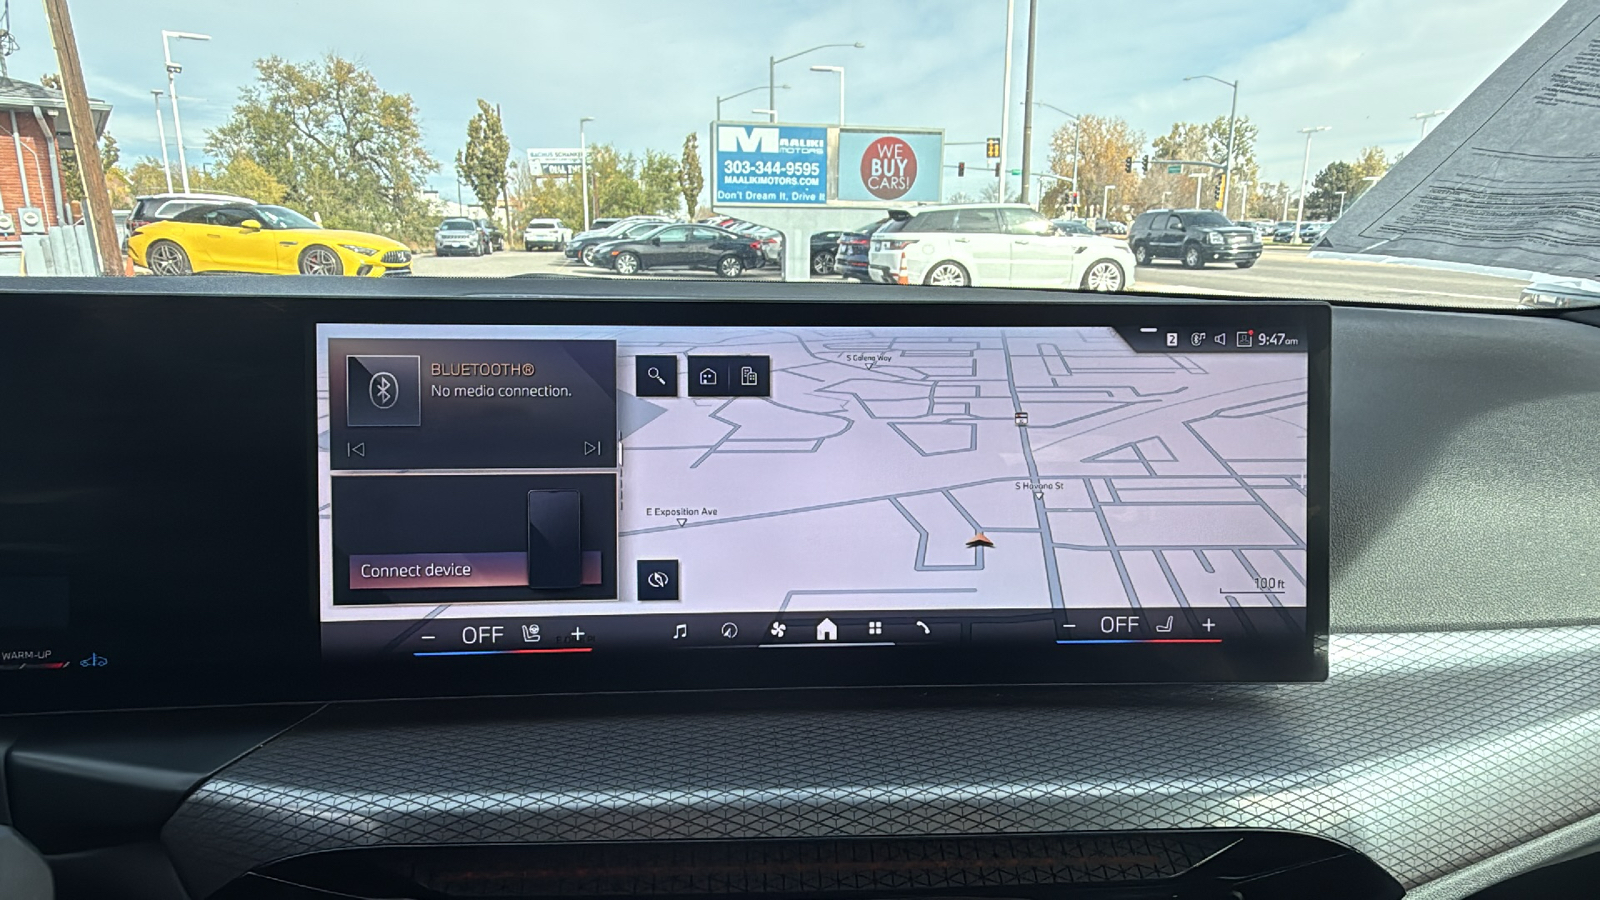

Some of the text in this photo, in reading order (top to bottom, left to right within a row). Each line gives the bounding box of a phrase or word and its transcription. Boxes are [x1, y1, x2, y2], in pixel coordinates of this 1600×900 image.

[877, 143, 904, 159] WE
[724, 160, 820, 176] 303-344-9595
[871, 158, 908, 177] BUY
[724, 175, 819, 186] MAALIKIMOTORS.COM
[867, 176, 910, 190] CARS!
[717, 190, 743, 200] Don't
[745, 190, 776, 200] Dream
[791, 191, 816, 201] Drive
[877, 354, 892, 362] Way
[431, 385, 572, 398] No media connection.
[1015, 482, 1064, 490] S Havana St
[646, 507, 718, 517] E Exposition Ave
[361, 562, 471, 578] Connect device
[1254, 578, 1285, 589] 100 ft
[1100, 616, 1140, 633] OFF
[462, 626, 504, 644] OFF
[1, 650, 52, 661] WARM-UP
